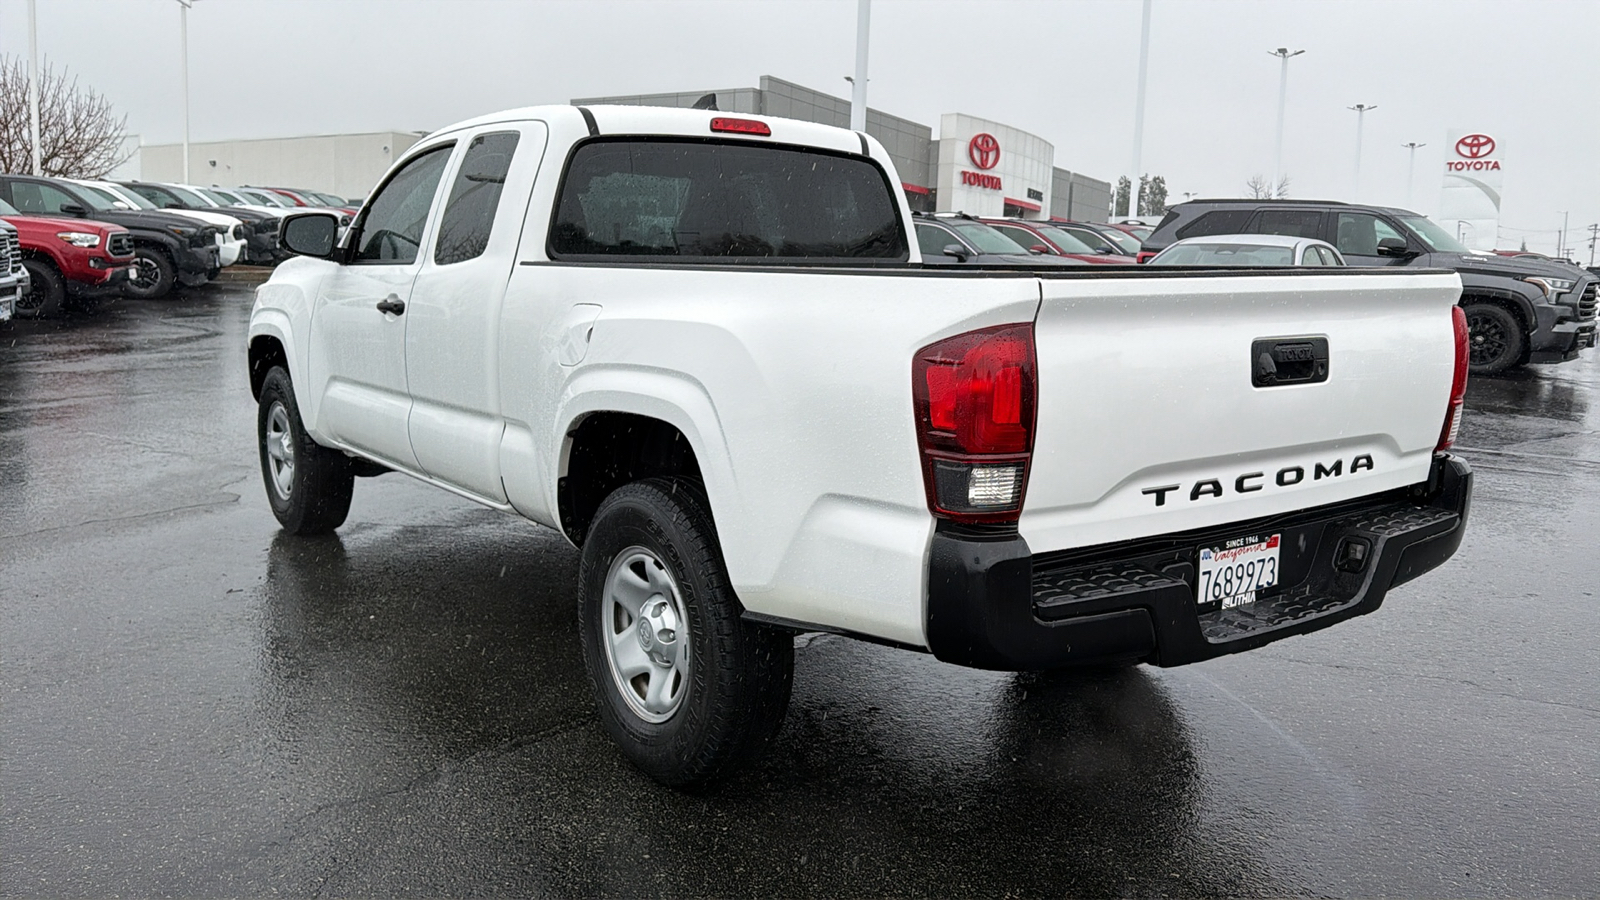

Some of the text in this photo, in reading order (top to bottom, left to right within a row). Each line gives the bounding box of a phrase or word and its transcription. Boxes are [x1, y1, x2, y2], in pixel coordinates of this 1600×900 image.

[1447, 160, 1501, 172] TOYOTA
[961, 170, 1002, 191] TOYOTA
[1281, 347, 1314, 360] TOYOTA
[1141, 453, 1374, 507] TACOMA
[1226, 538, 1244, 549] SINCE
[1245, 535, 1258, 545] 1946
[1213, 543, 1267, 562] California
[1230, 590, 1256, 607] LITHIA
